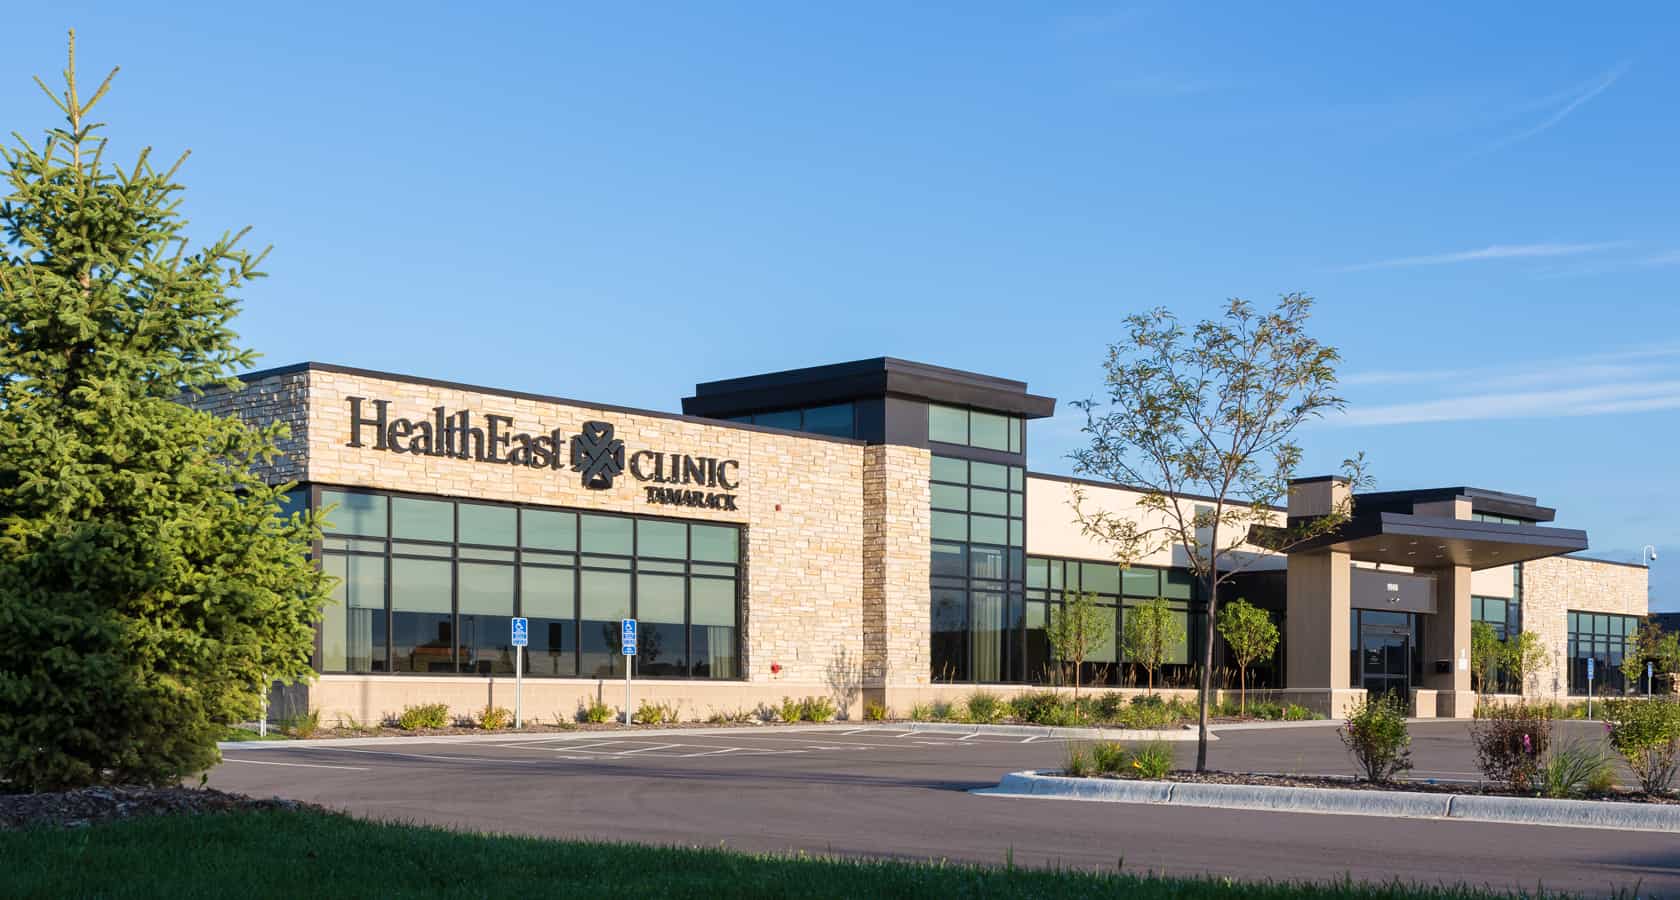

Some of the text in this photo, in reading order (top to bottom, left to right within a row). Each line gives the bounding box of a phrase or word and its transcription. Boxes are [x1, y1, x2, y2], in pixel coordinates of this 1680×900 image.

[346, 396, 739, 490] HealthEast CLINIC
[644, 486, 738, 511] TAMARACK
